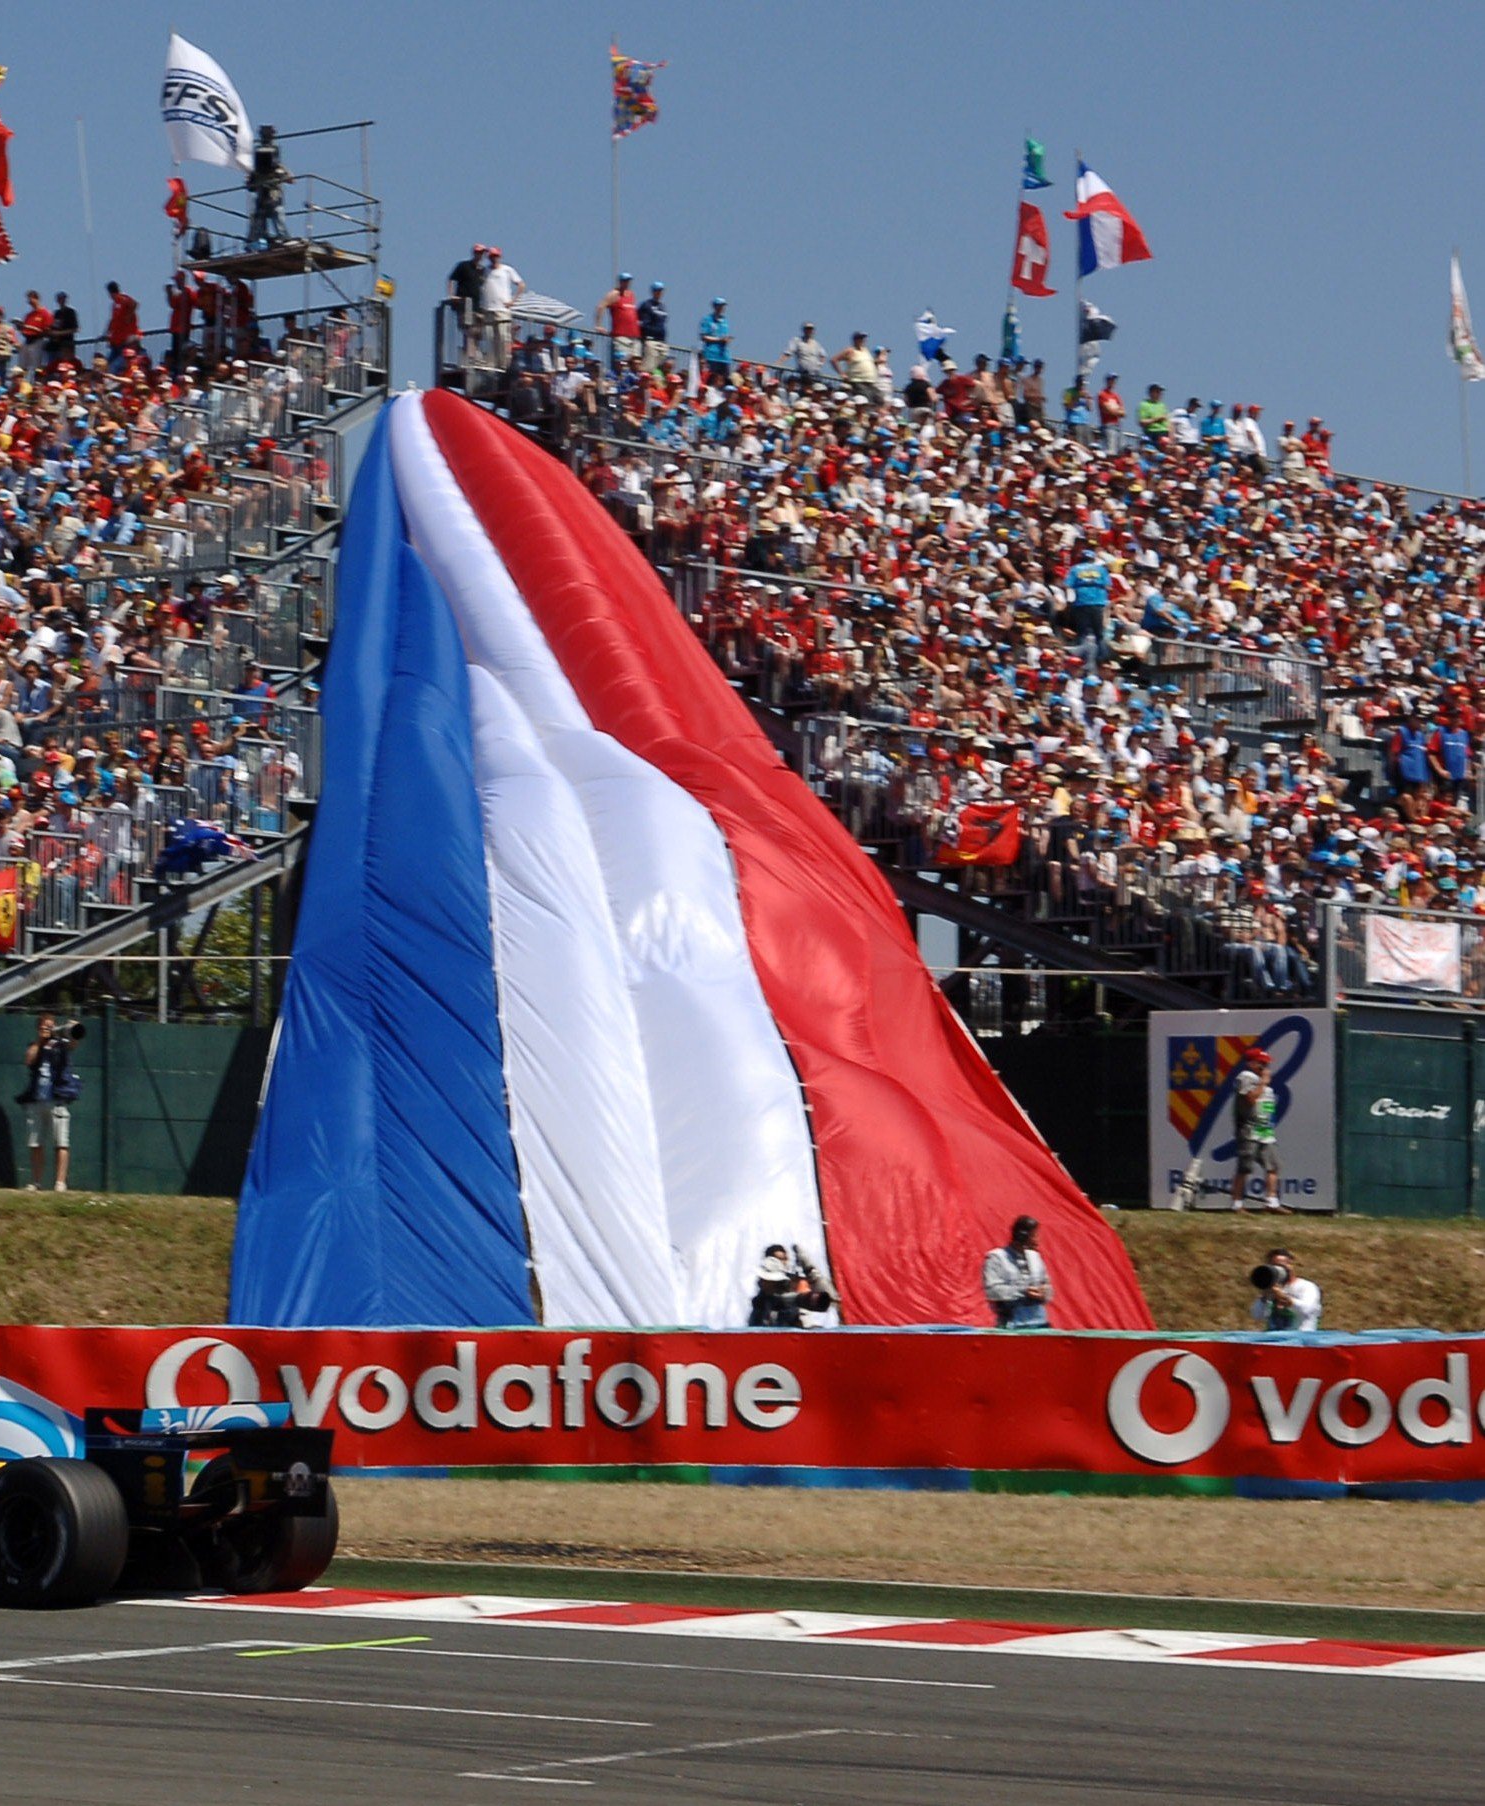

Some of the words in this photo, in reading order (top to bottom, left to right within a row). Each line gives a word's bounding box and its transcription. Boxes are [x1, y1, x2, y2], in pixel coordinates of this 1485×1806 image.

[162, 81, 238, 133] FFS
[280, 1338, 802, 1430] vodafone
[1250, 1352, 1485, 1445] vod
